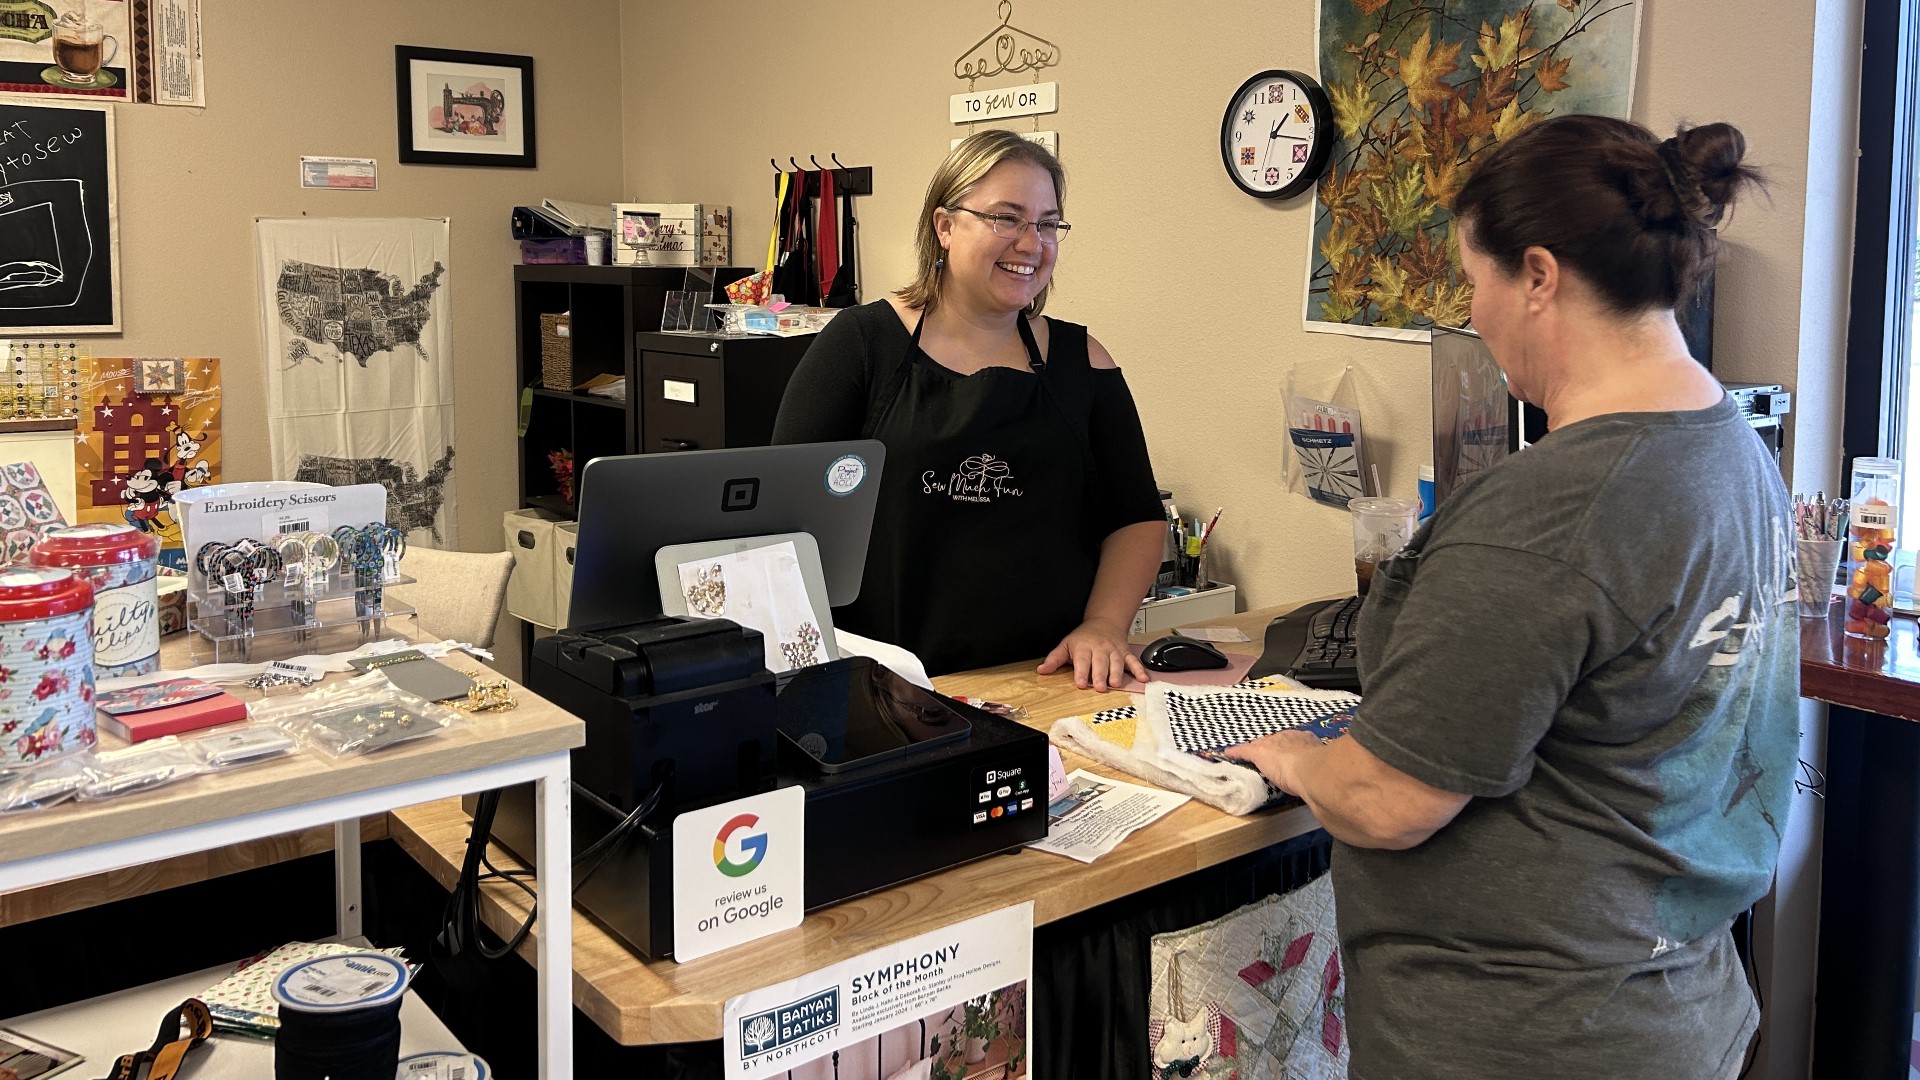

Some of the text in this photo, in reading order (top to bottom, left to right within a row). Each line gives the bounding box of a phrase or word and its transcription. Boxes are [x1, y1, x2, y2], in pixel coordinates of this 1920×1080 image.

[1, 12, 49, 29] CHA
[965, 92, 1037, 115] TO sew OR
[1252, 92, 1265, 105] 11
[1292, 88, 1297, 101] 1
[0, 120, 31, 146] AT
[1235, 130, 1242, 142] 9
[1251, 169, 1259, 181] 7
[1286, 167, 1294, 180] 5
[344, 332, 376, 356] TEXAS
[1301, 436, 1333, 444] SCHMETZ
[921, 470, 1024, 498] Sew Much Fun
[204, 492, 337, 514] Embroidery Scissors
[94, 600, 150, 637] uilty
[94, 624, 144, 653] Clips
[997, 767, 1022, 780] Square
[715, 884, 767, 908] review us
[697, 896, 784, 932] on Google
[851, 942, 960, 994] SYMPHONY
[851, 967, 944, 1006] Block of the Month
[782, 995, 833, 1025] BANYAN
[782, 1010, 833, 1040] BATIKS
[743, 1027, 839, 1070] BY NORTHCOTT
